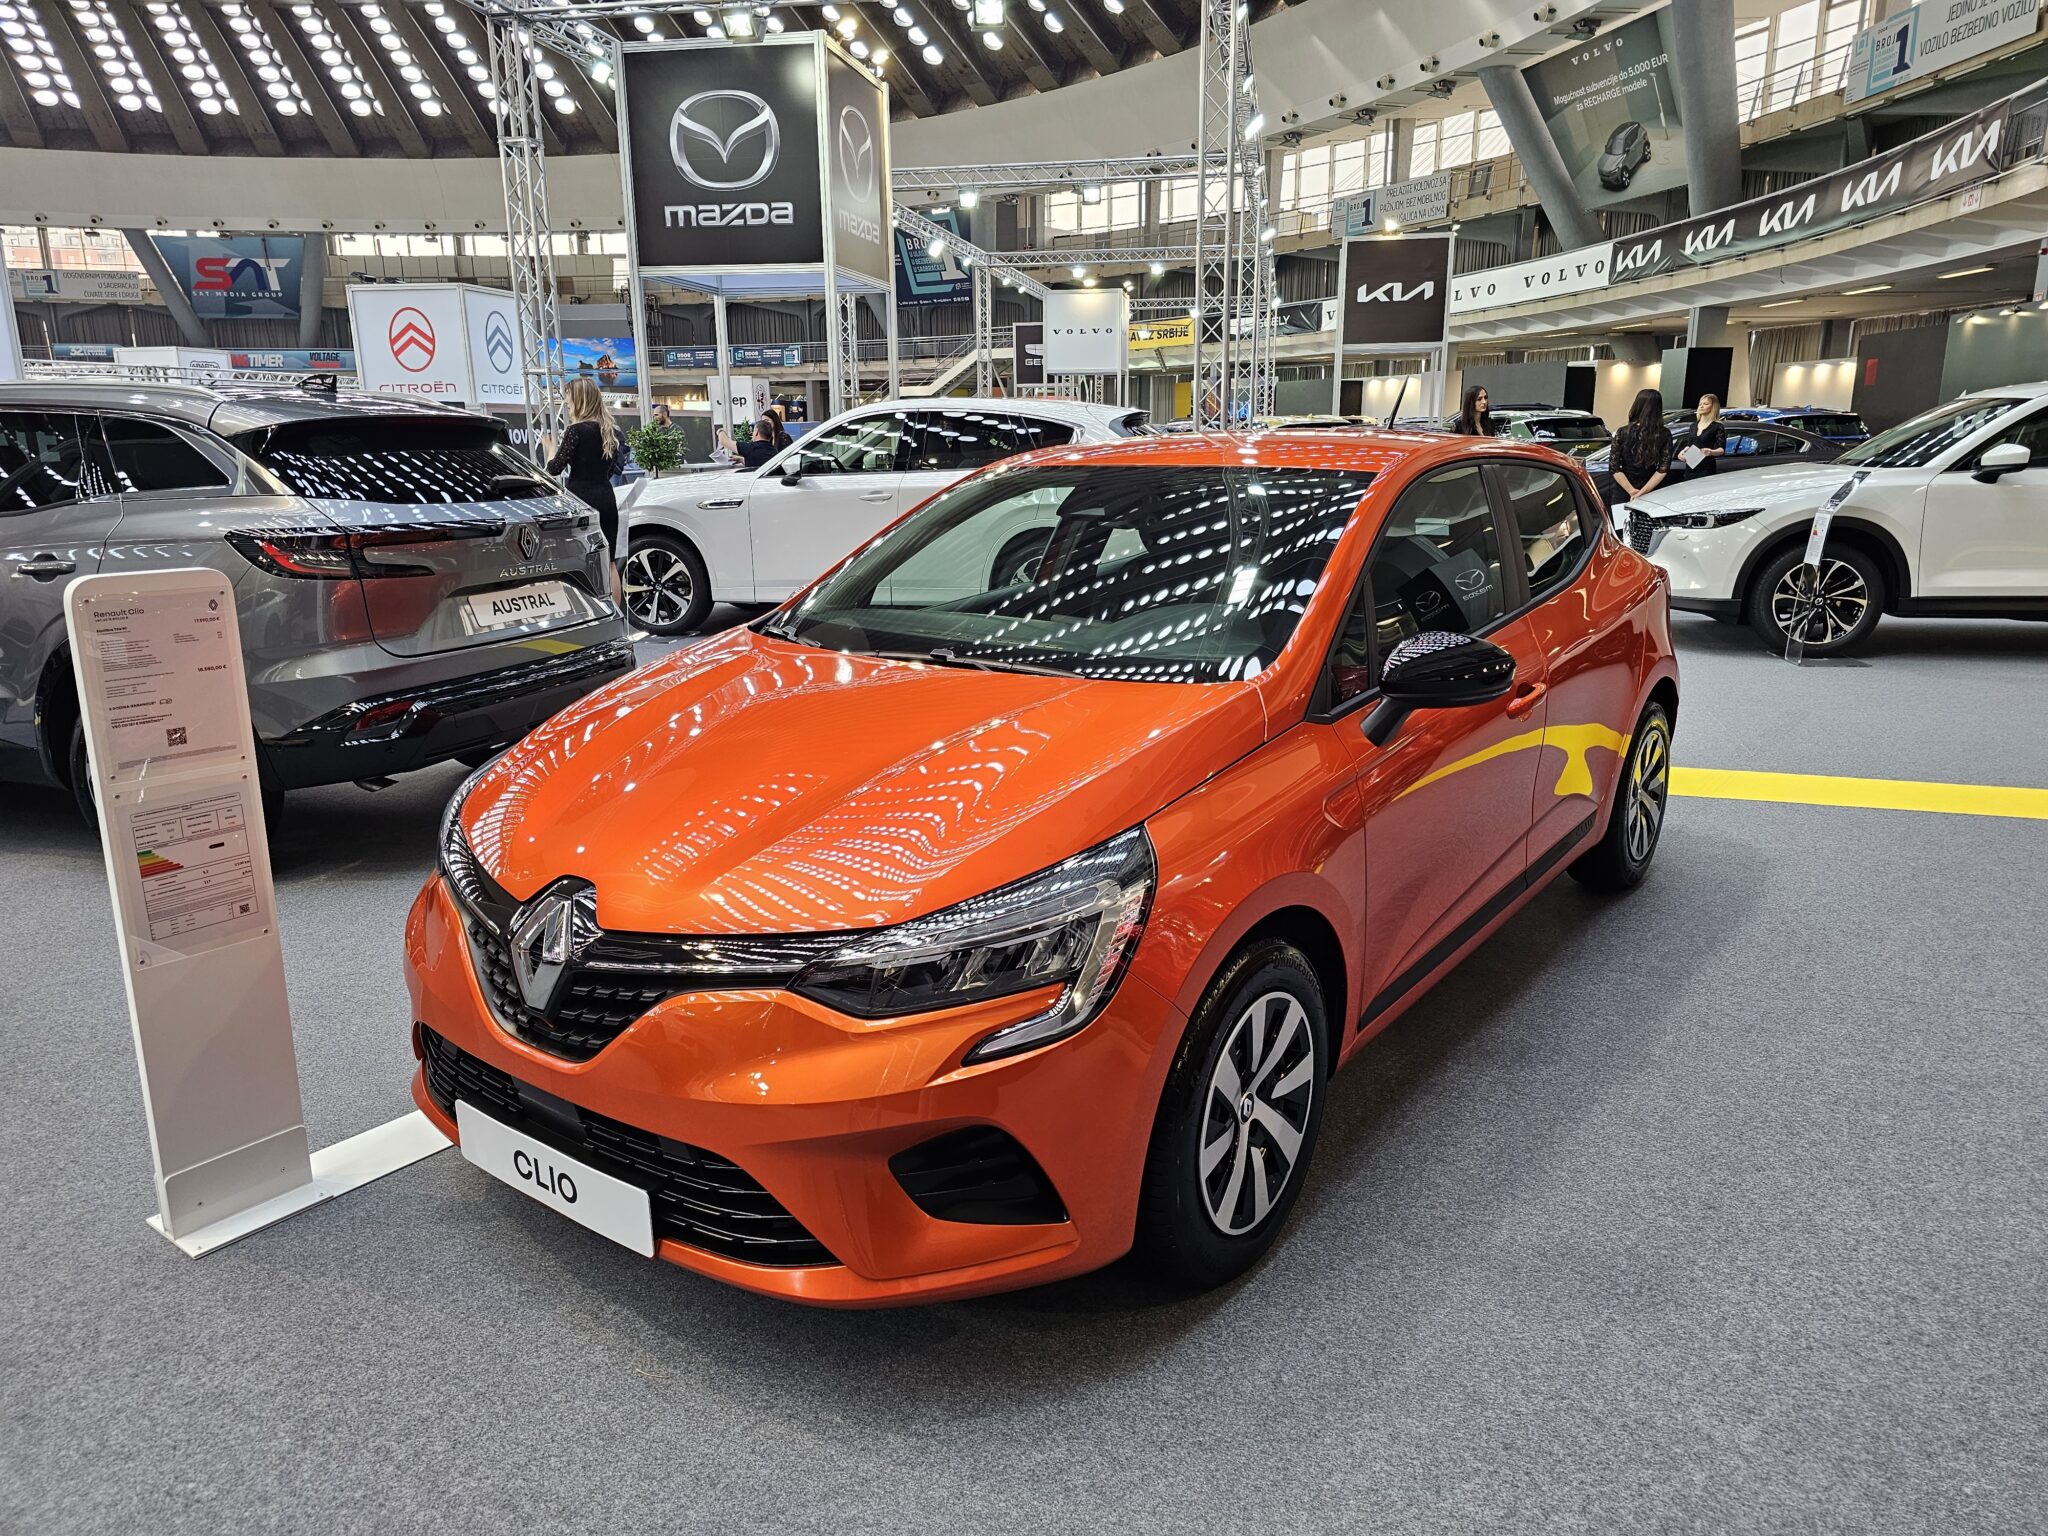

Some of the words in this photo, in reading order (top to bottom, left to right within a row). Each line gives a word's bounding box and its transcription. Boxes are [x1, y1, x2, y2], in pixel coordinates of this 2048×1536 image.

[1920, 33, 1949, 57] VOZILO
[1950, 10, 1999, 45] BEZBEDNO
[2001, 0, 2036, 24] VOZILO
[1571, 38, 1624, 65] VOLVO
[1875, 33, 1897, 51] BROJ
[1892, 24, 1911, 75] 1
[1553, 86, 1587, 105] Mogućnost
[1586, 74, 1619, 97] subvencije
[1619, 71, 1628, 81] do
[1628, 60, 1651, 77] 5.000
[1651, 53, 1669, 69] EUR
[1576, 102, 1584, 112] za
[1583, 88, 1622, 108] RECHARGE
[1621, 78, 1648, 95] modele
[1438, 179, 1447, 188] SA
[664, 201, 794, 228] mazda
[1361, 198, 1373, 226] 1
[42, 275, 58, 294] 1
[1524, 259, 1605, 288] VOLVO
[1454, 283, 1496, 302] LVO
[1156, 327, 1189, 340] SRBIJE
[309, 352, 341, 362] VOLTAGE
[379, 381, 457, 393] CITROËN
[499, 563, 558, 578] AUSTRAL
[93, 609, 128, 618] Renault
[492, 592, 556, 616] AUSTRAL
[513, 1150, 578, 1204] CLIO
